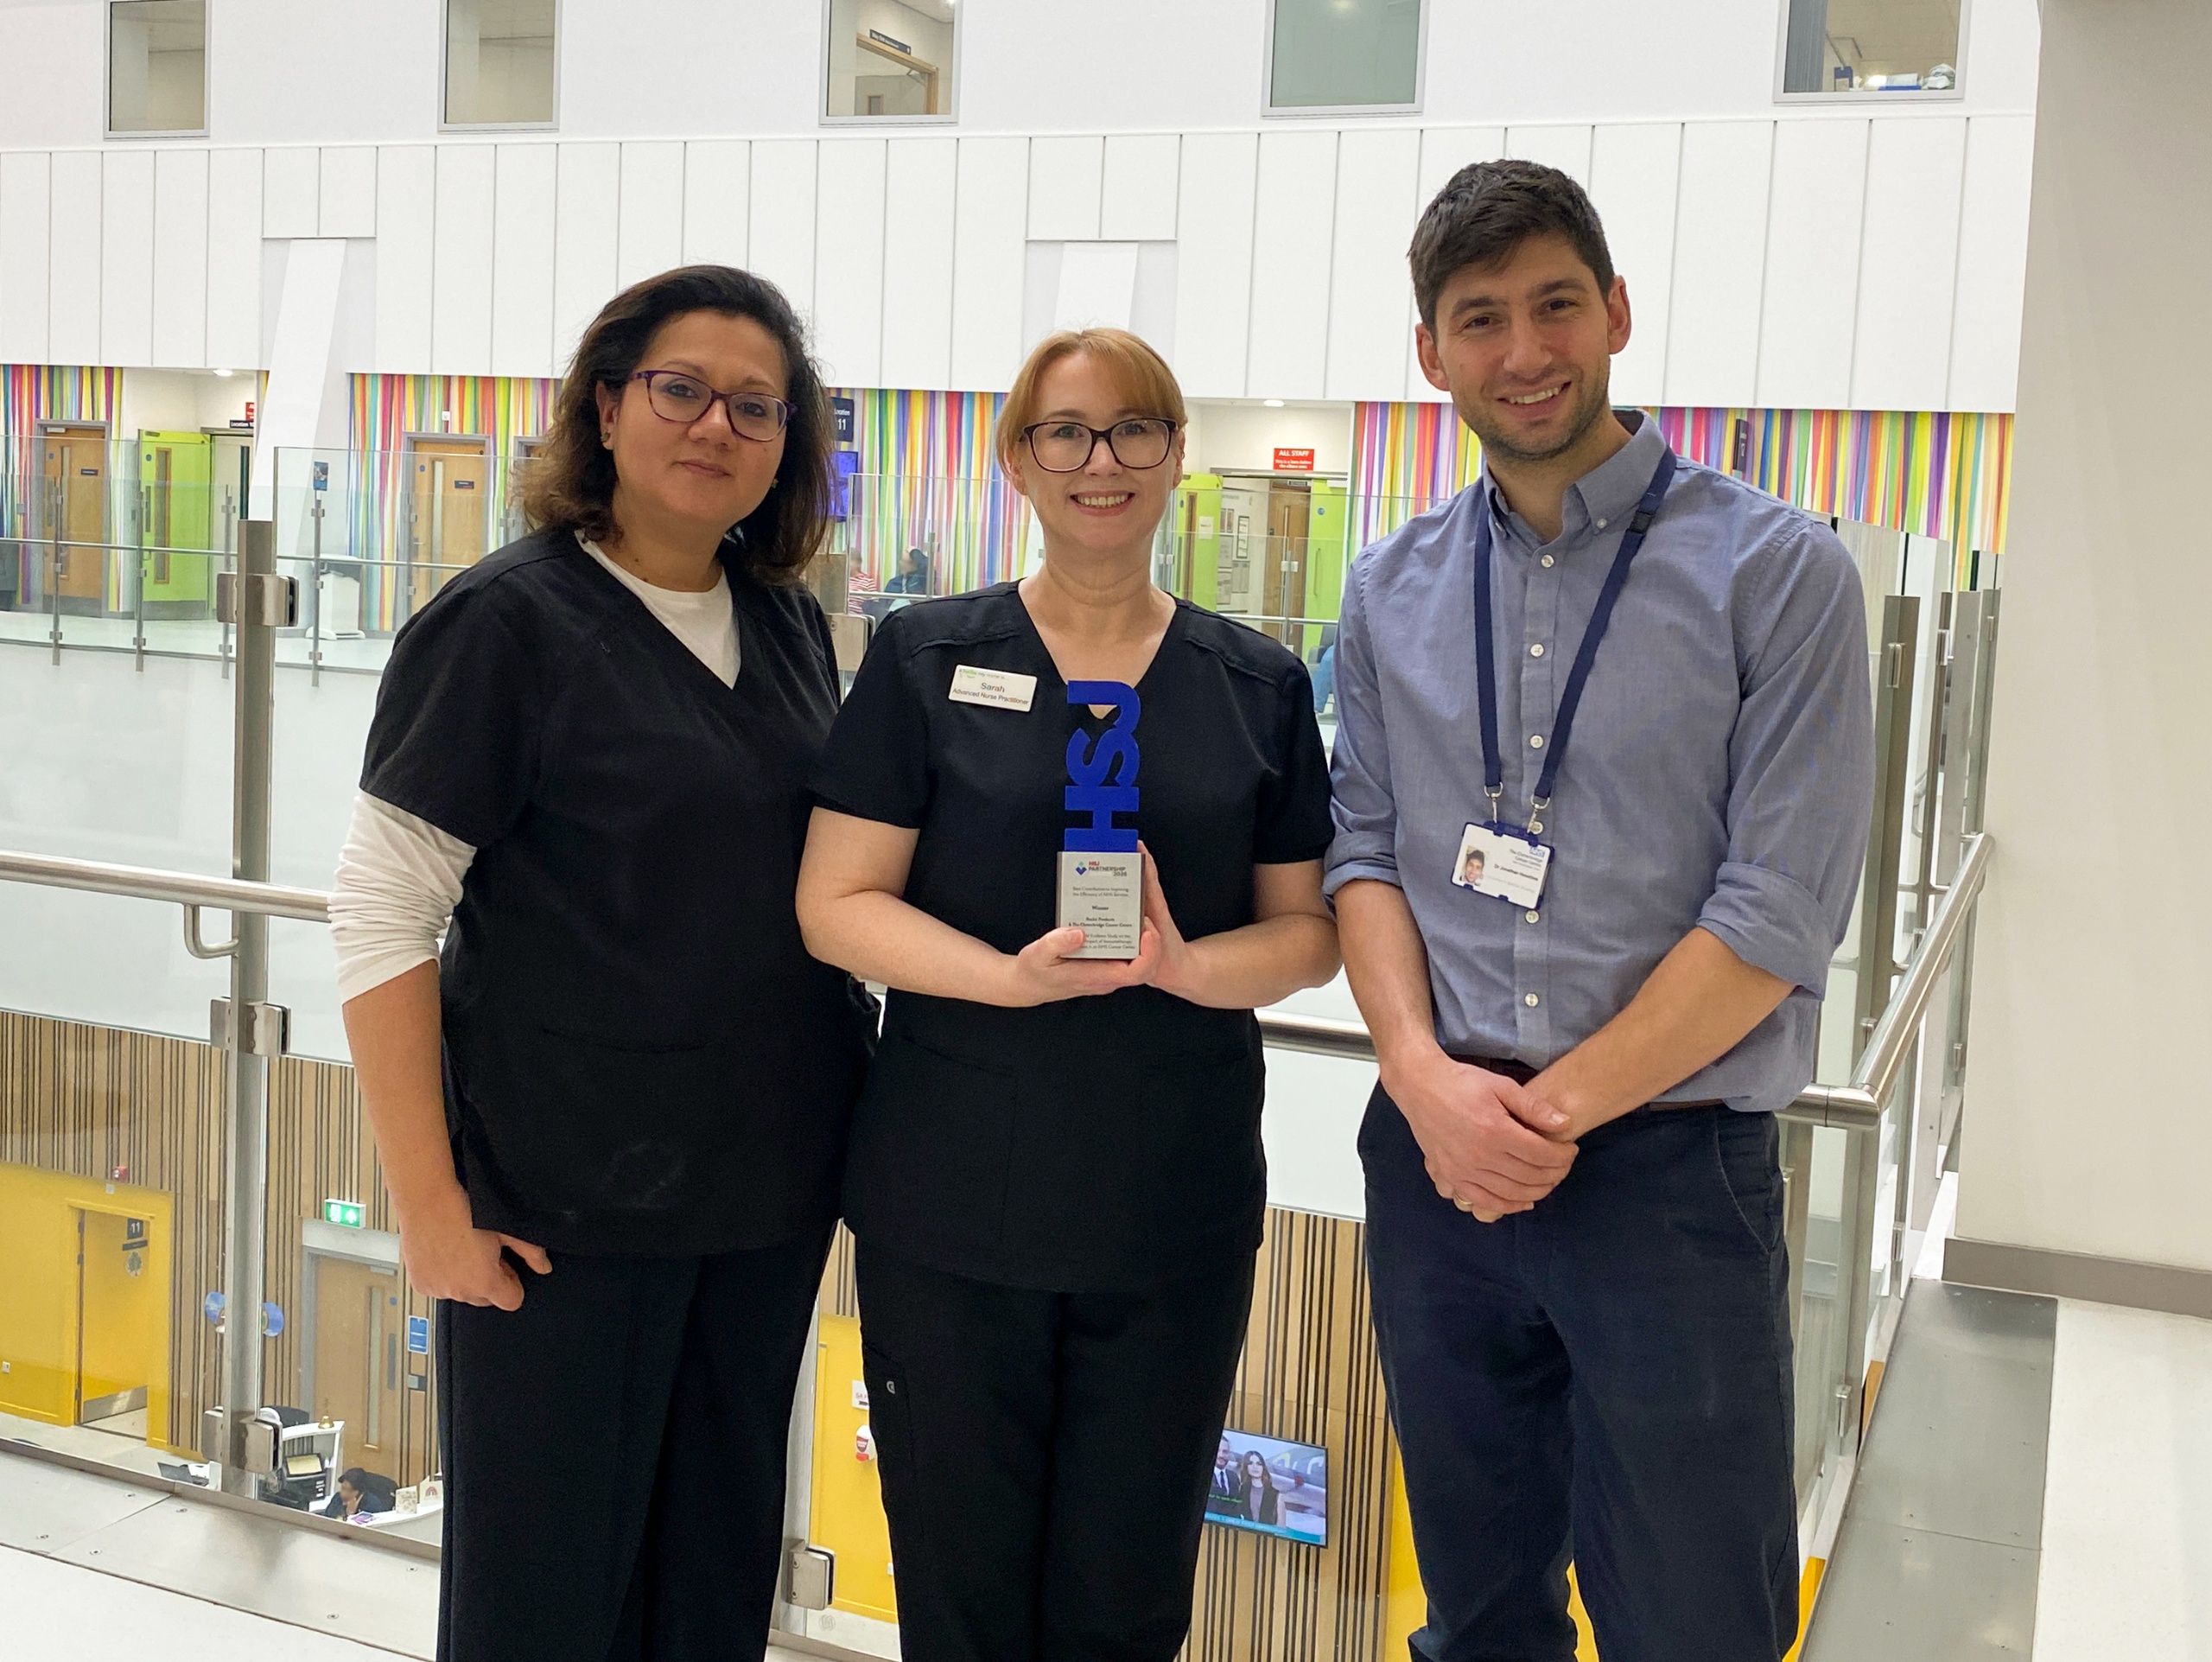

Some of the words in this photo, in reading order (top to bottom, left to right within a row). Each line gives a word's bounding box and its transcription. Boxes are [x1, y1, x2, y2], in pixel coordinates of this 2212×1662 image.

[838, 418, 846, 430] 11
[981, 682, 1005, 693] Sarah
[952, 688, 980, 697] Advanced
[998, 694, 1029, 705] Practitioner
[1065, 680, 1141, 852] HSJ
[131, 1221, 140, 1233] 11
